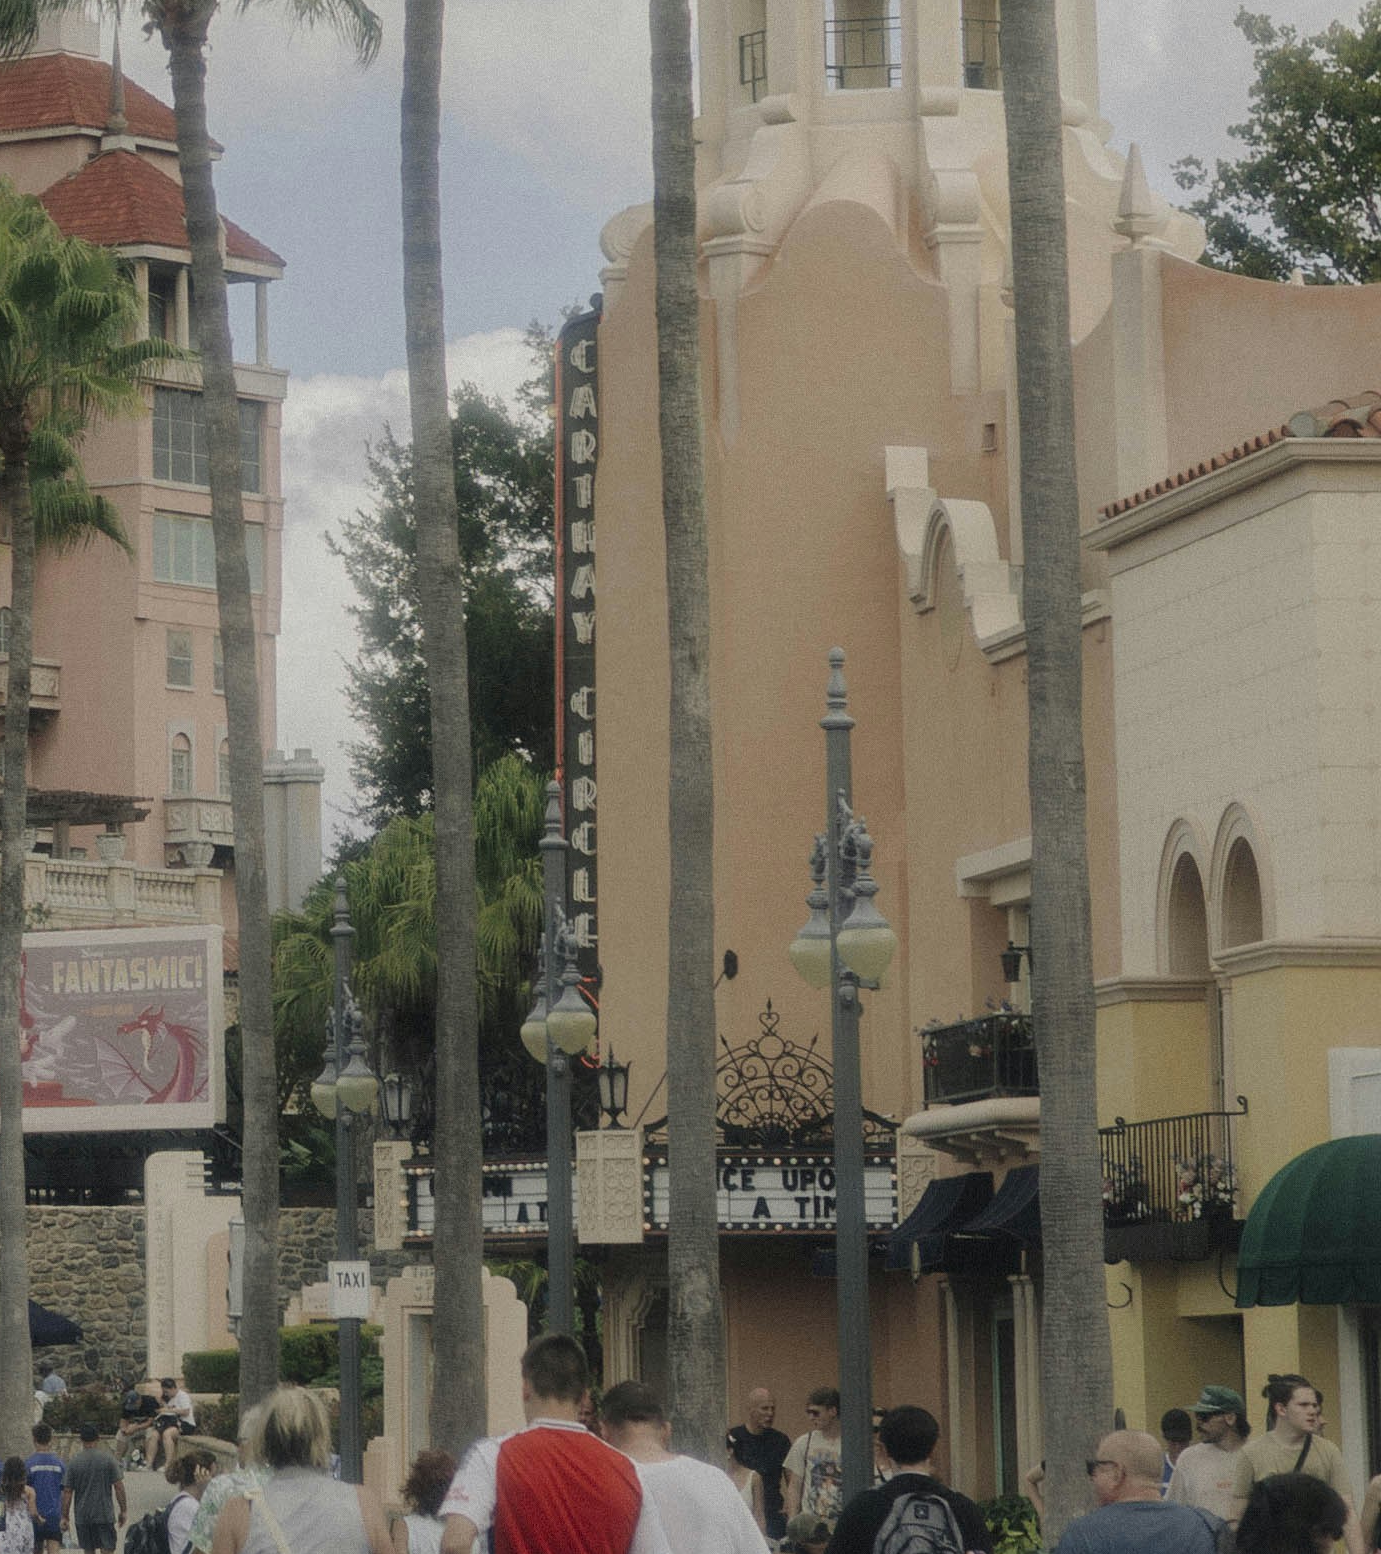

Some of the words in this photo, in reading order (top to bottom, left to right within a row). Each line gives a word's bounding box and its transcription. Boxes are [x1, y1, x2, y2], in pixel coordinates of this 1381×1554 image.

[570, 340, 598, 644] CARTHAY
[570, 685, 598, 948] CIRCLE
[53, 955, 203, 993] FANTASMIC!
[782, 1168, 837, 1191] UPO
[752, 1196, 771, 1219] A
[795, 1196, 838, 1219] TIM
[337, 1271, 366, 1289] TAXI
